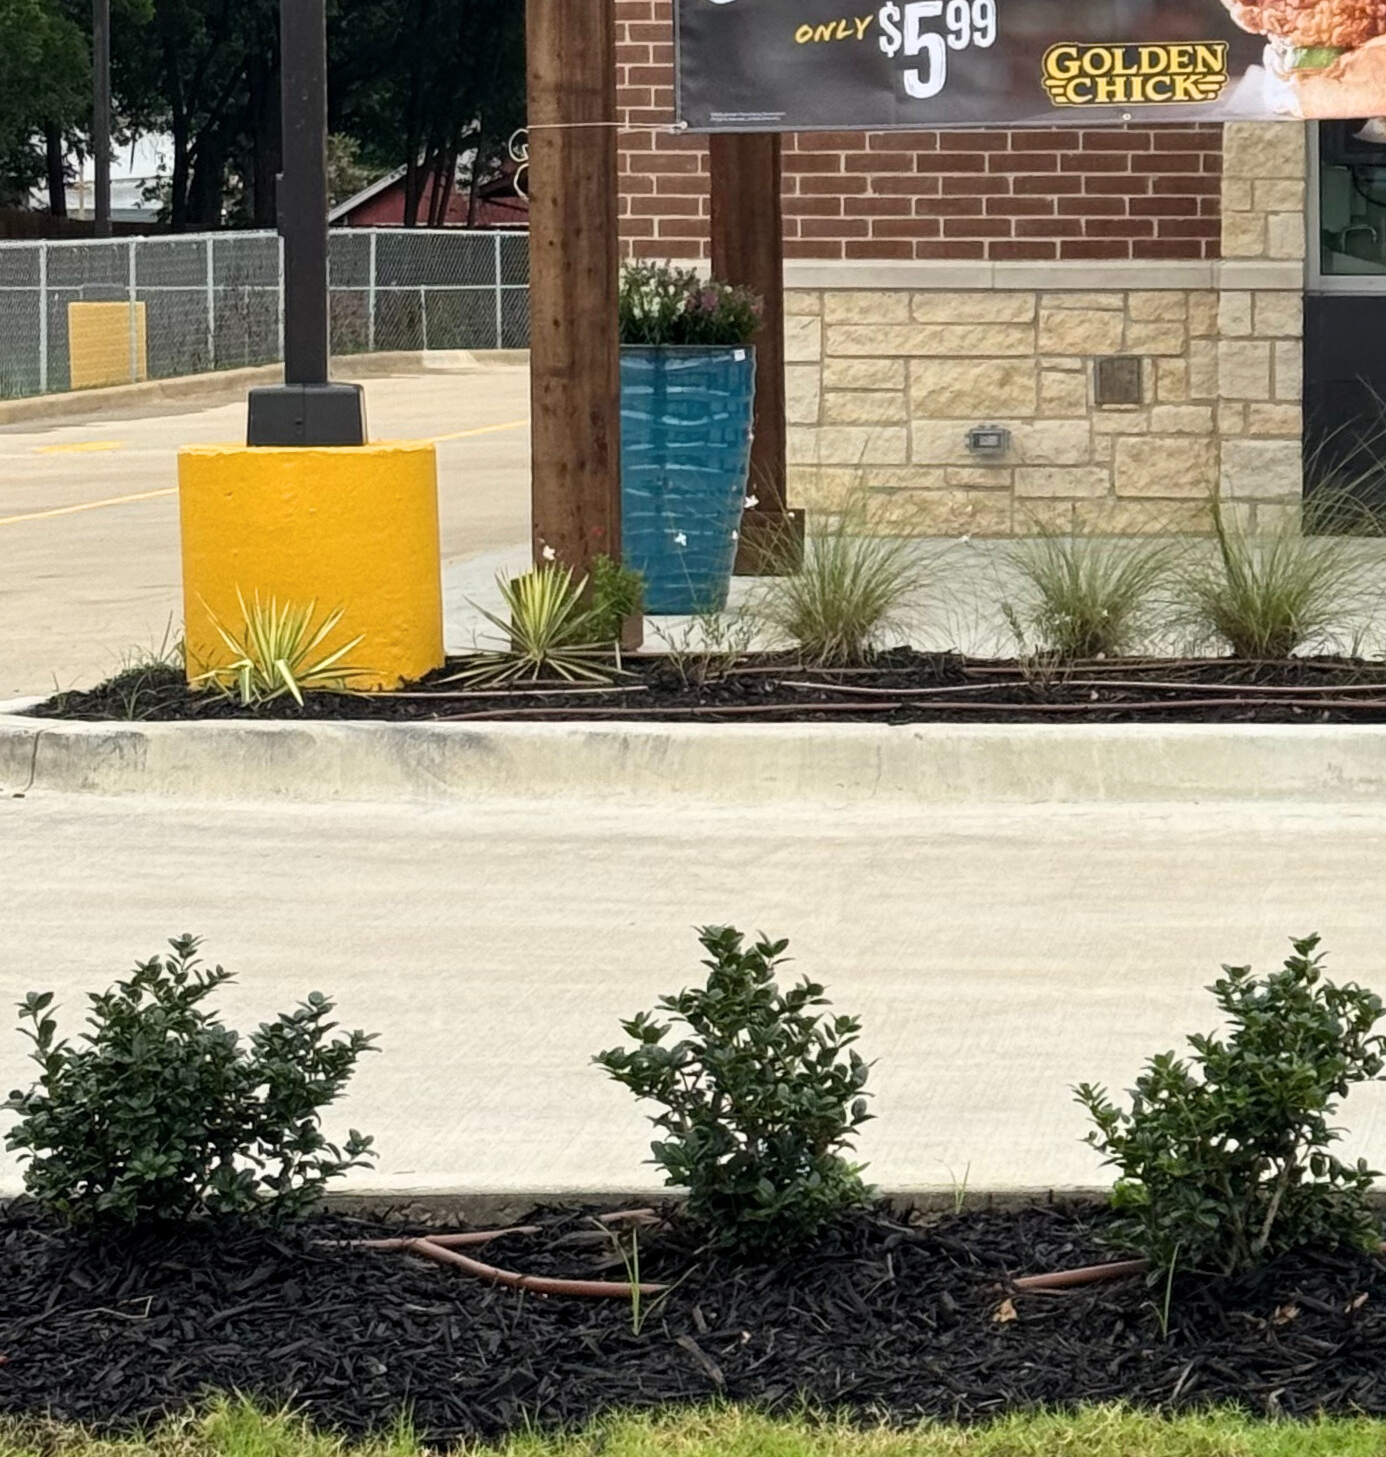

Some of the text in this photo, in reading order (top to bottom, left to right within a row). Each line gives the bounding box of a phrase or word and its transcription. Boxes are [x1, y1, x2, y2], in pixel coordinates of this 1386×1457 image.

[794, 15, 874, 45] ONLY
[1046, 43, 1226, 78] GOLDEN
[1067, 73, 1202, 104] CHICK
